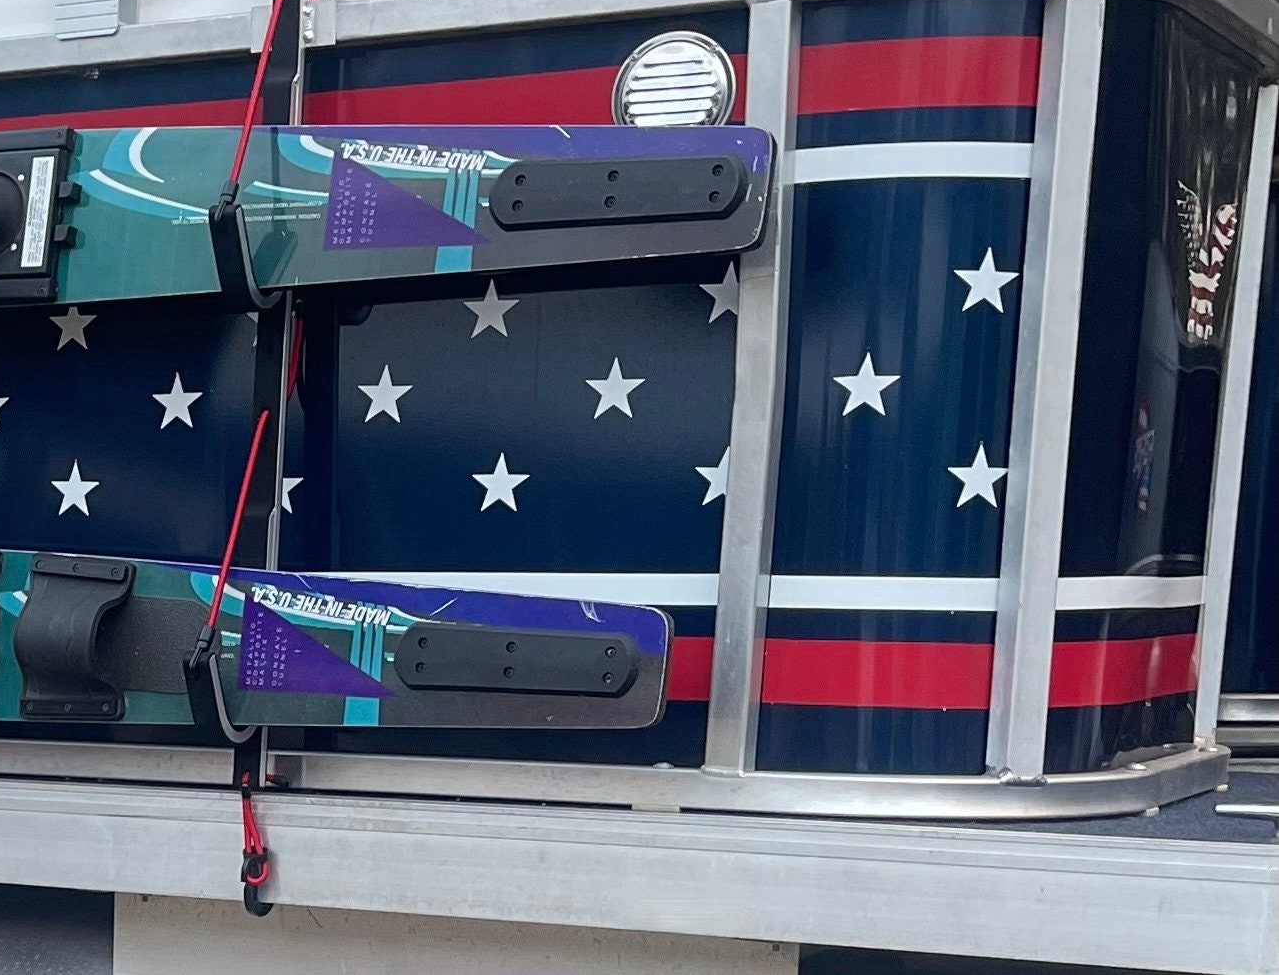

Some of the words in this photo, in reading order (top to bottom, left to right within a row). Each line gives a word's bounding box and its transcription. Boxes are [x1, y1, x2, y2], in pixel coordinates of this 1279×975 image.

[340, 142, 383, 162] U.S.A.
[384, 145, 417, 164] THE
[417, 149, 437, 166] IN
[438, 150, 488, 171] MADE
[250, 586, 293, 609] U.S.A.
[293, 594, 324, 613] THE
[325, 599, 343, 618] IN
[343, 603, 392, 626] MADE
